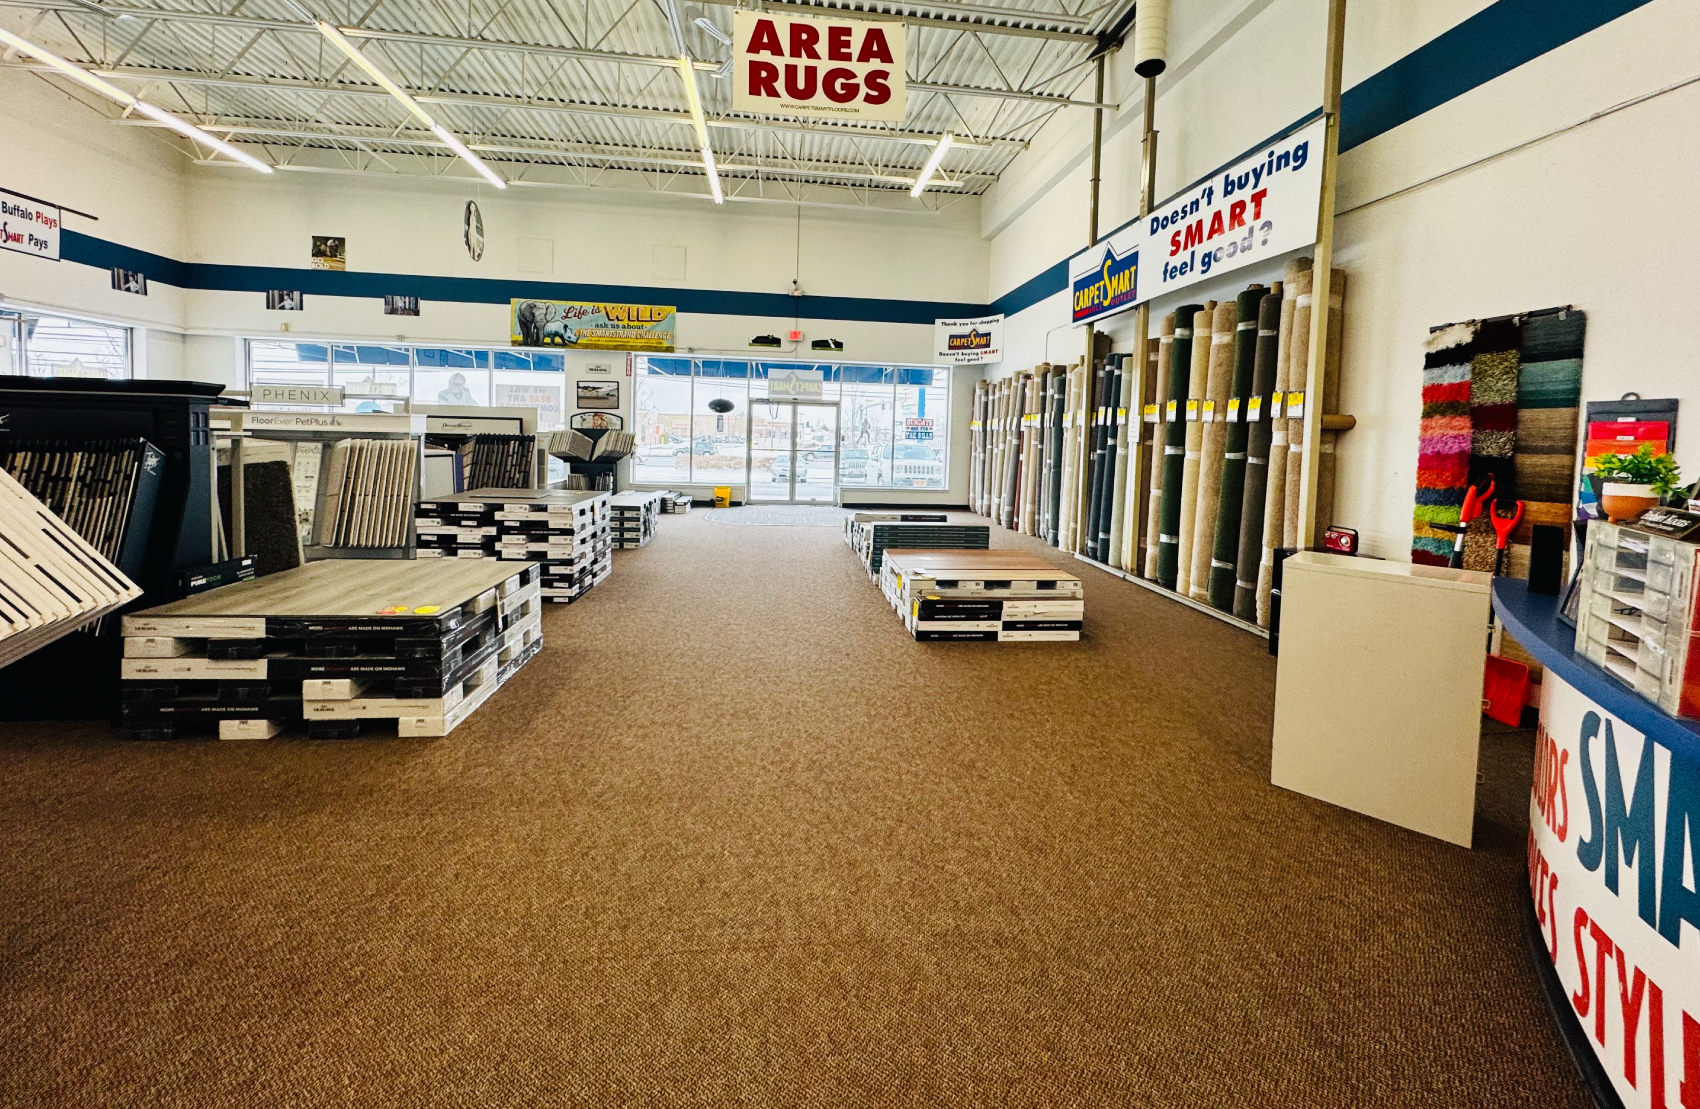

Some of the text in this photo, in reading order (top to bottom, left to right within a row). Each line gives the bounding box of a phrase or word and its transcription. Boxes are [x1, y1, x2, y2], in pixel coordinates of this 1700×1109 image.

[746, 19, 894, 64] AREA
[748, 60, 892, 105] RUGS
[1150, 140, 1309, 236] Doesn't buying
[1, 200, 58, 229] Buffalo Plays
[1169, 187, 1268, 257] SMART
[28, 233, 48, 251] Pays
[1163, 250, 1195, 283] feel
[1200, 225, 1254, 274] good
[1110, 289, 1136, 306] OUTLET
[561, 304, 668, 323] Life is WILD
[580, 329, 672, 339] THE SMARTSTRAND CHALLENGE
[262, 388, 330, 401] PHENIX
[251, 416, 328, 426] FloorEver PetPlus
